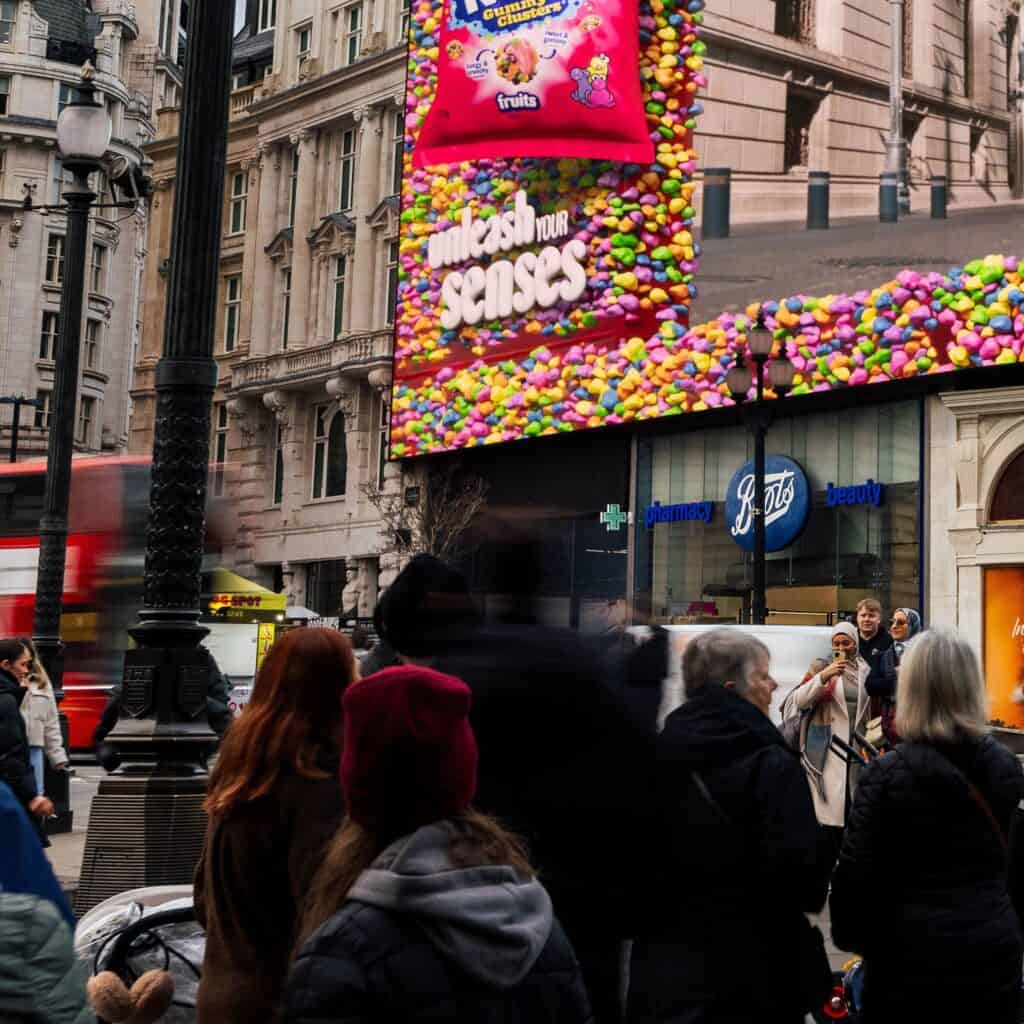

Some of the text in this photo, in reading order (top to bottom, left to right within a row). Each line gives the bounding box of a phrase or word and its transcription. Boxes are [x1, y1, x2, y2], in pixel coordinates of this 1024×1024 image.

[497, 2, 562, 27] Clusters
[496, 93, 538, 110] fruits
[428, 189, 569, 269] unleash YOUR
[440, 239, 587, 330] senses
[731, 469, 795, 536] Bots
[826, 479, 882, 507] beauty
[645, 501, 712, 528] pharmacy
